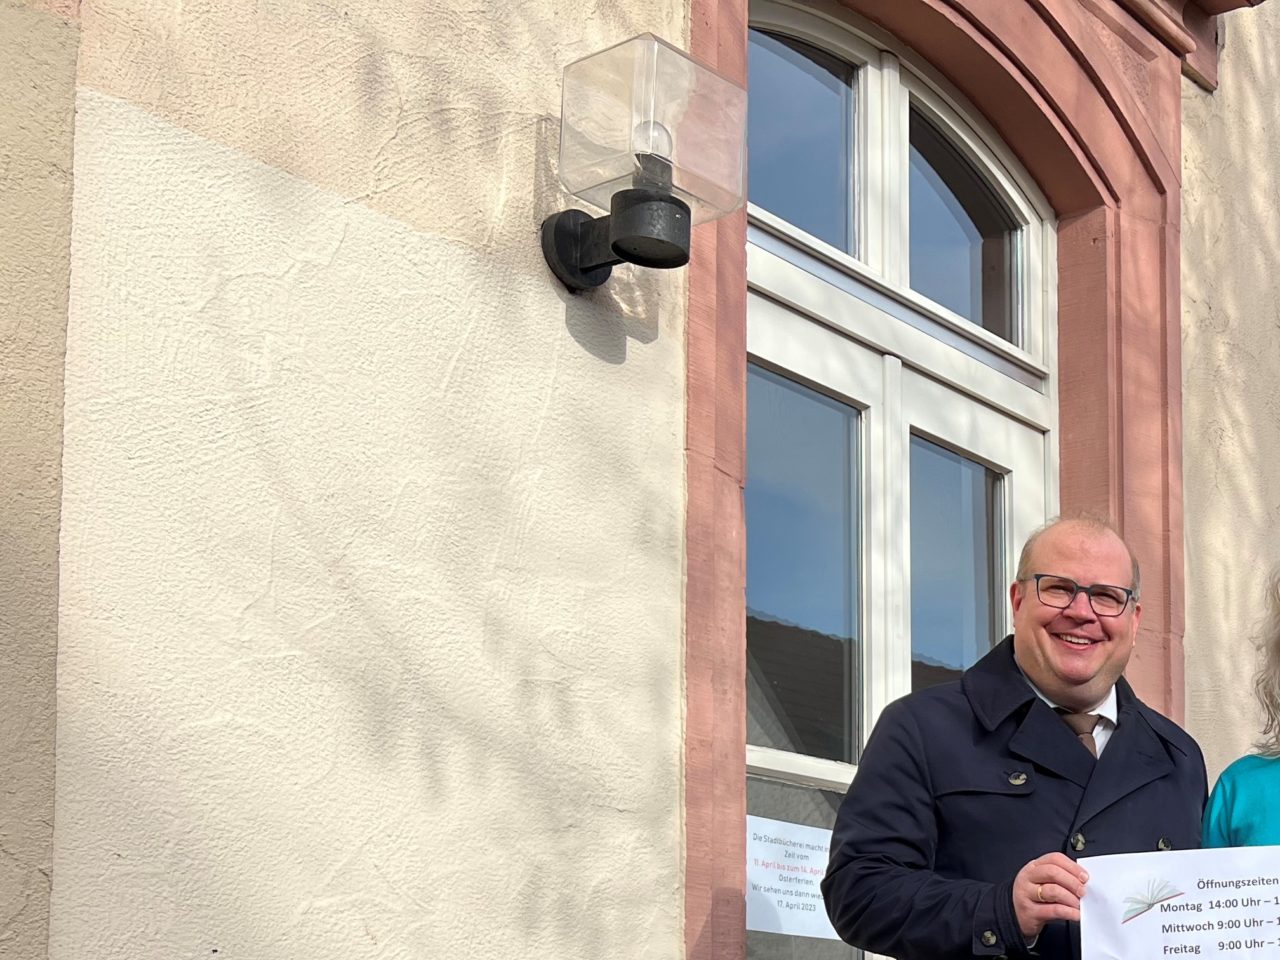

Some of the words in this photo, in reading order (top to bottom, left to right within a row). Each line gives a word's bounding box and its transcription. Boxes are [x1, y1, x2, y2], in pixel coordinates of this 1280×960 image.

[753, 833, 762, 841] Die
[762, 860, 776, 870] April
[763, 885, 781, 894] sehen
[1197, 875, 1279, 890] Öffnungszeiten
[1160, 901, 1203, 913] Montag
[1209, 898, 1238, 910] 14:00
[1242, 897, 1261, 907] Uhr
[1162, 921, 1214, 933] Mittwoch
[1217, 919, 1241, 930] 9:00
[1244, 918, 1264, 927] Uhr
[1163, 944, 1201, 955] Freitag
[1218, 940, 1242, 950] 9:00
[1245, 938, 1265, 948] Uhr
